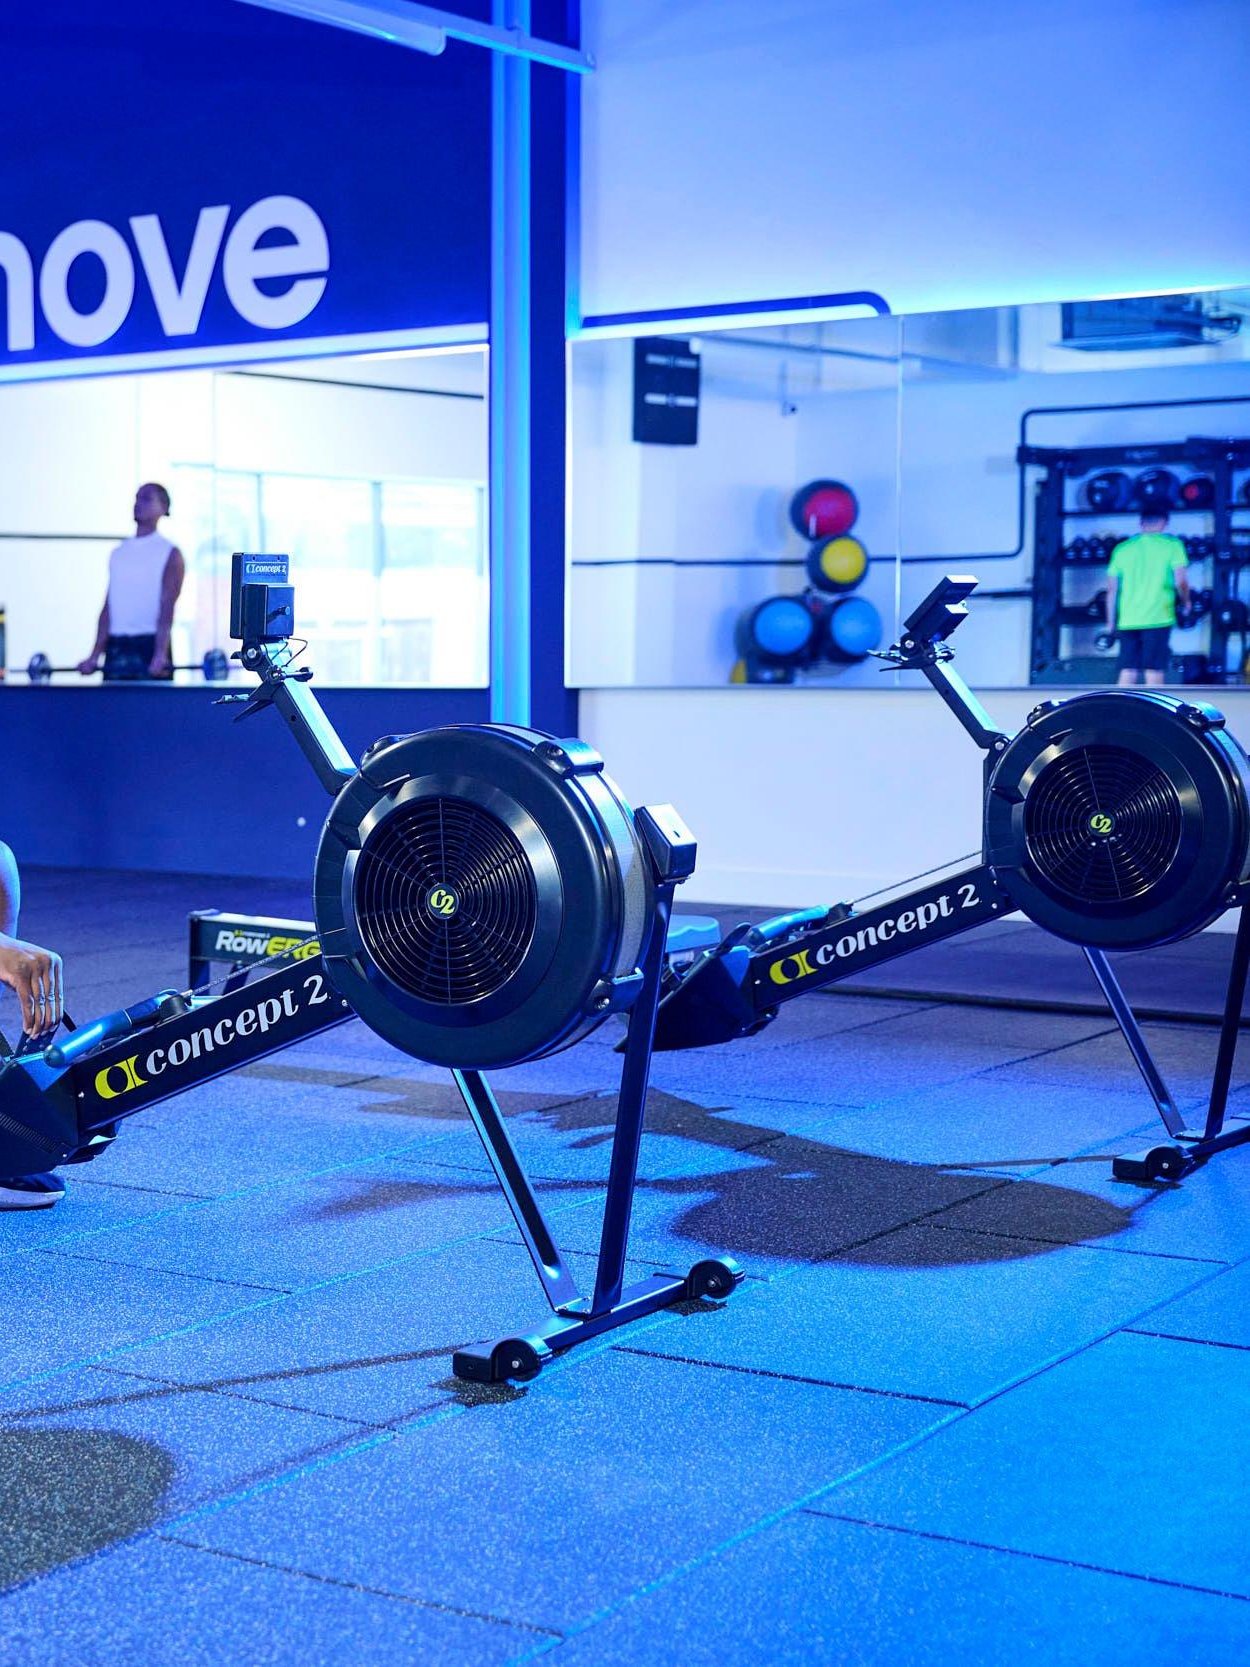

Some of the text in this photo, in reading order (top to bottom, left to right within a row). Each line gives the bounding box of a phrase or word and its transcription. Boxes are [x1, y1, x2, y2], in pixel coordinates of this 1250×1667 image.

[430, 889, 455, 914] C2
[816, 884, 980, 965] concept 2
[146, 974, 329, 1075] concept 2
